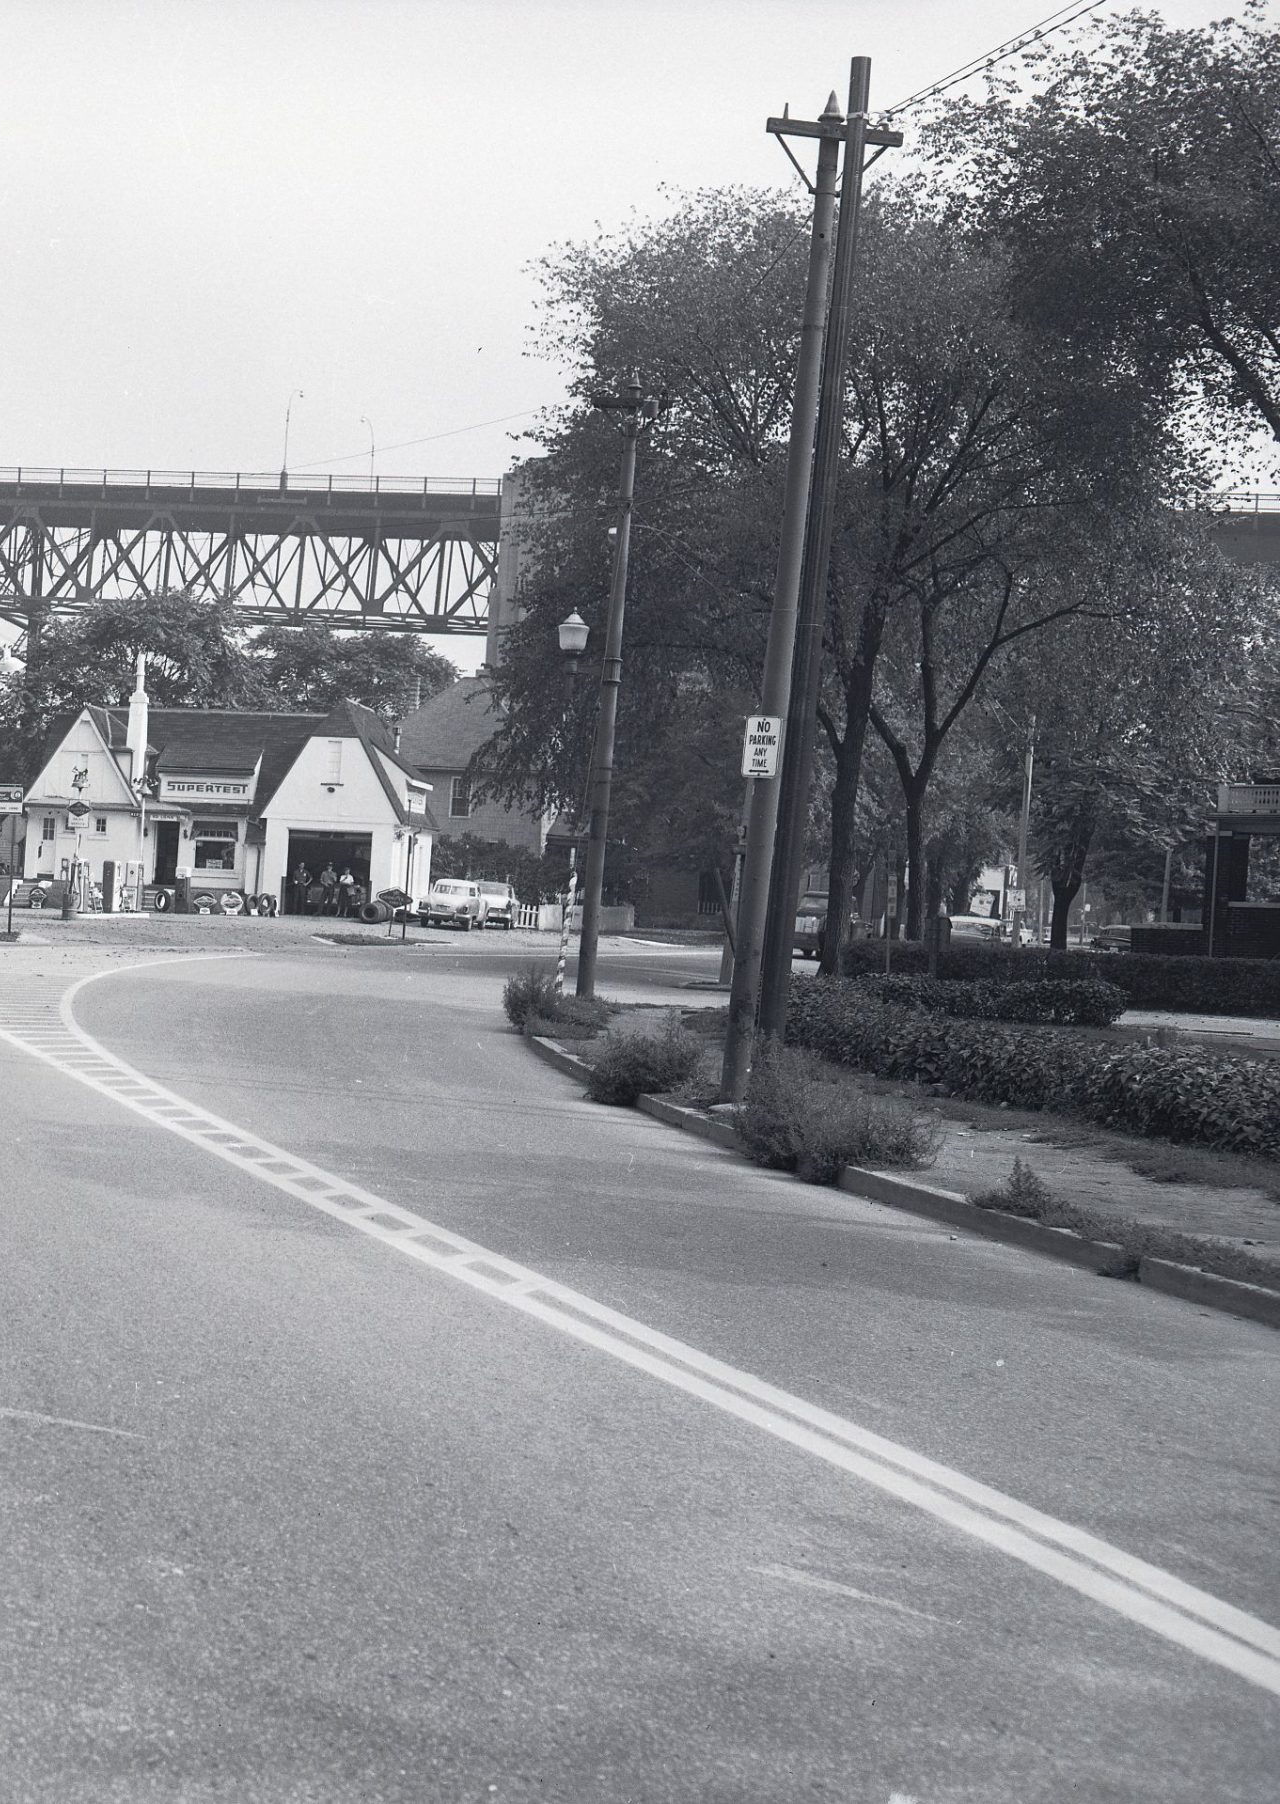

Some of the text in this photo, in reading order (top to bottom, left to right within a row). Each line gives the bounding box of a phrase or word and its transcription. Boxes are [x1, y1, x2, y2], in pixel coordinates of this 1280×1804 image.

[757, 721, 771, 733] NO
[748, 735, 777, 746] PARKING
[754, 747, 768, 757] ANY
[752, 758, 768, 768] TIME
[167, 781, 248, 794] SUPERTEST
